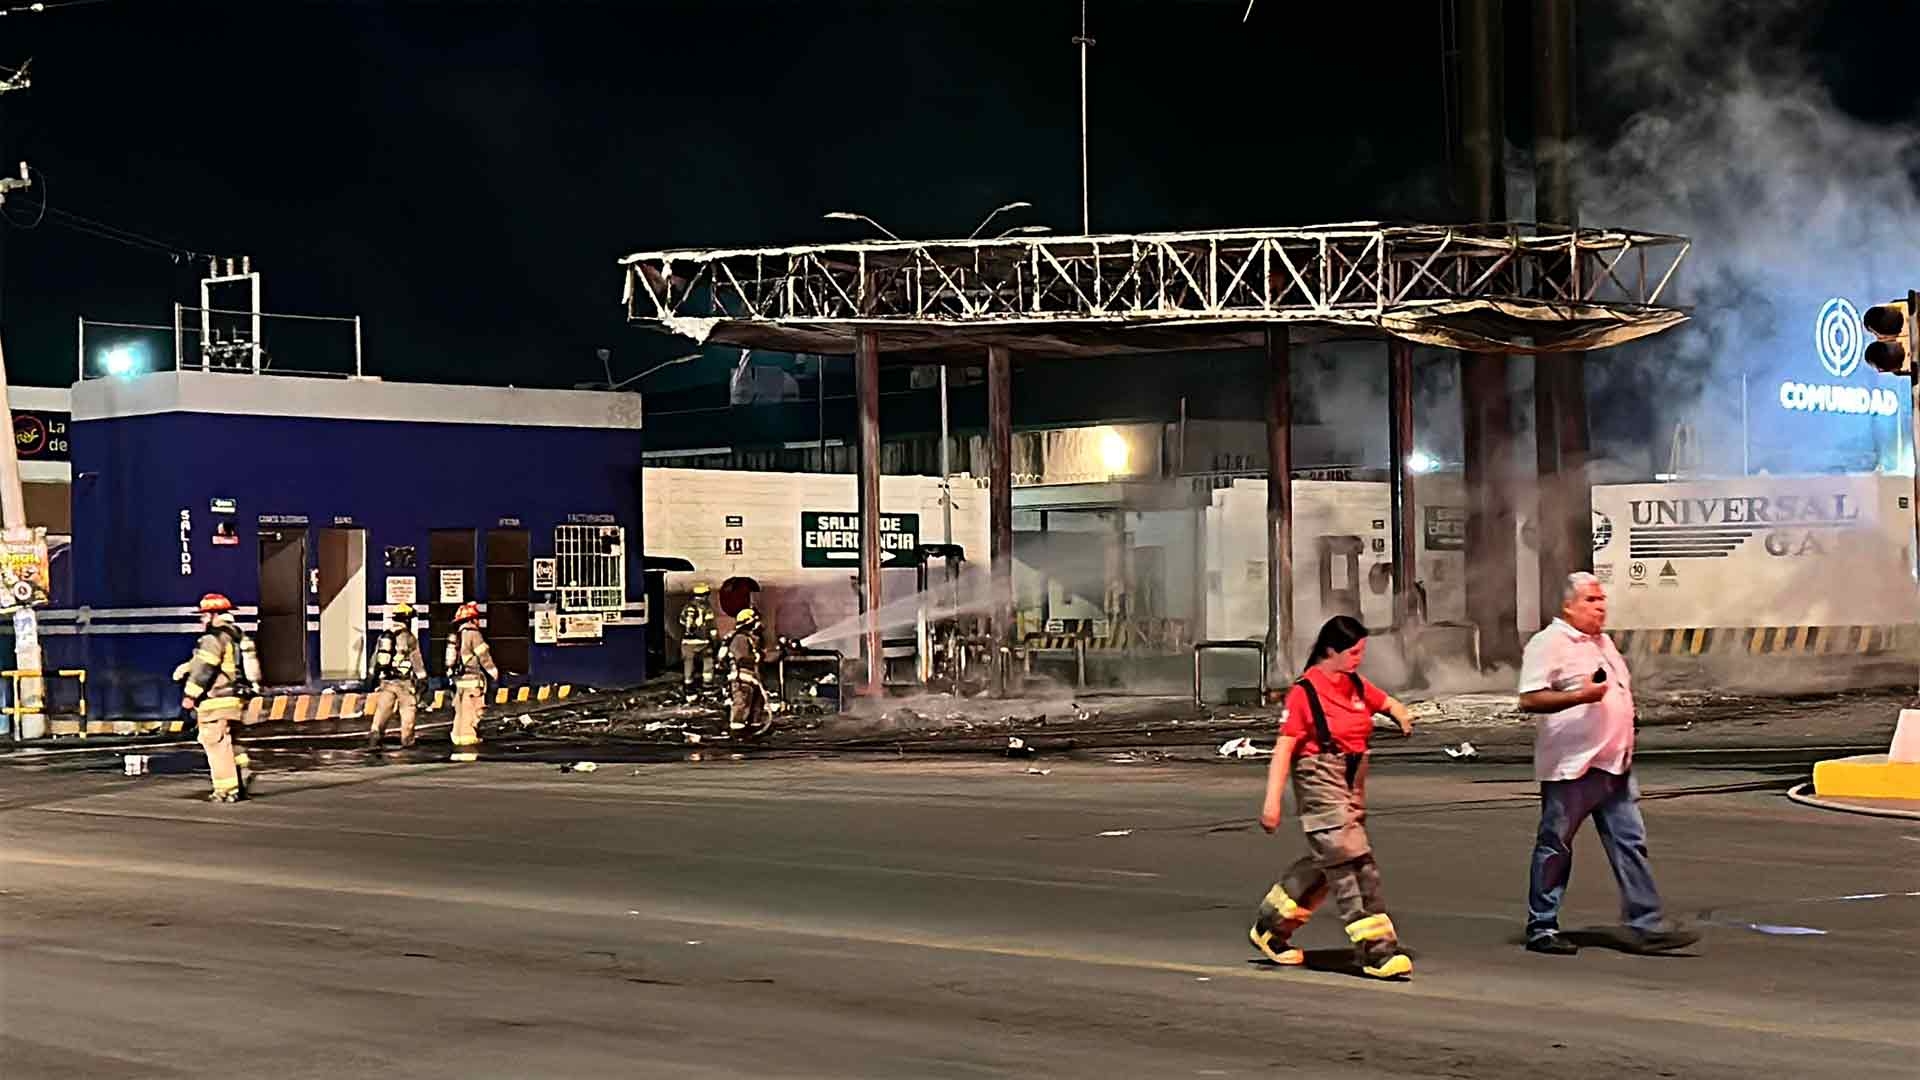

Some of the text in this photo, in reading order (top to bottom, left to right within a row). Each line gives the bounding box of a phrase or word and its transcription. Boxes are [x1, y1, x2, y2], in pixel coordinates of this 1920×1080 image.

[1780, 381, 1898, 416] COMUNIDAD
[49, 419, 65, 433] La
[49, 438, 68, 451] de
[1629, 494, 1858, 525] UNIVERSAL
[818, 515, 901, 531] SALI DE
[180, 509, 192, 575] SALIDA
[805, 530, 914, 550] EMERNCIA
